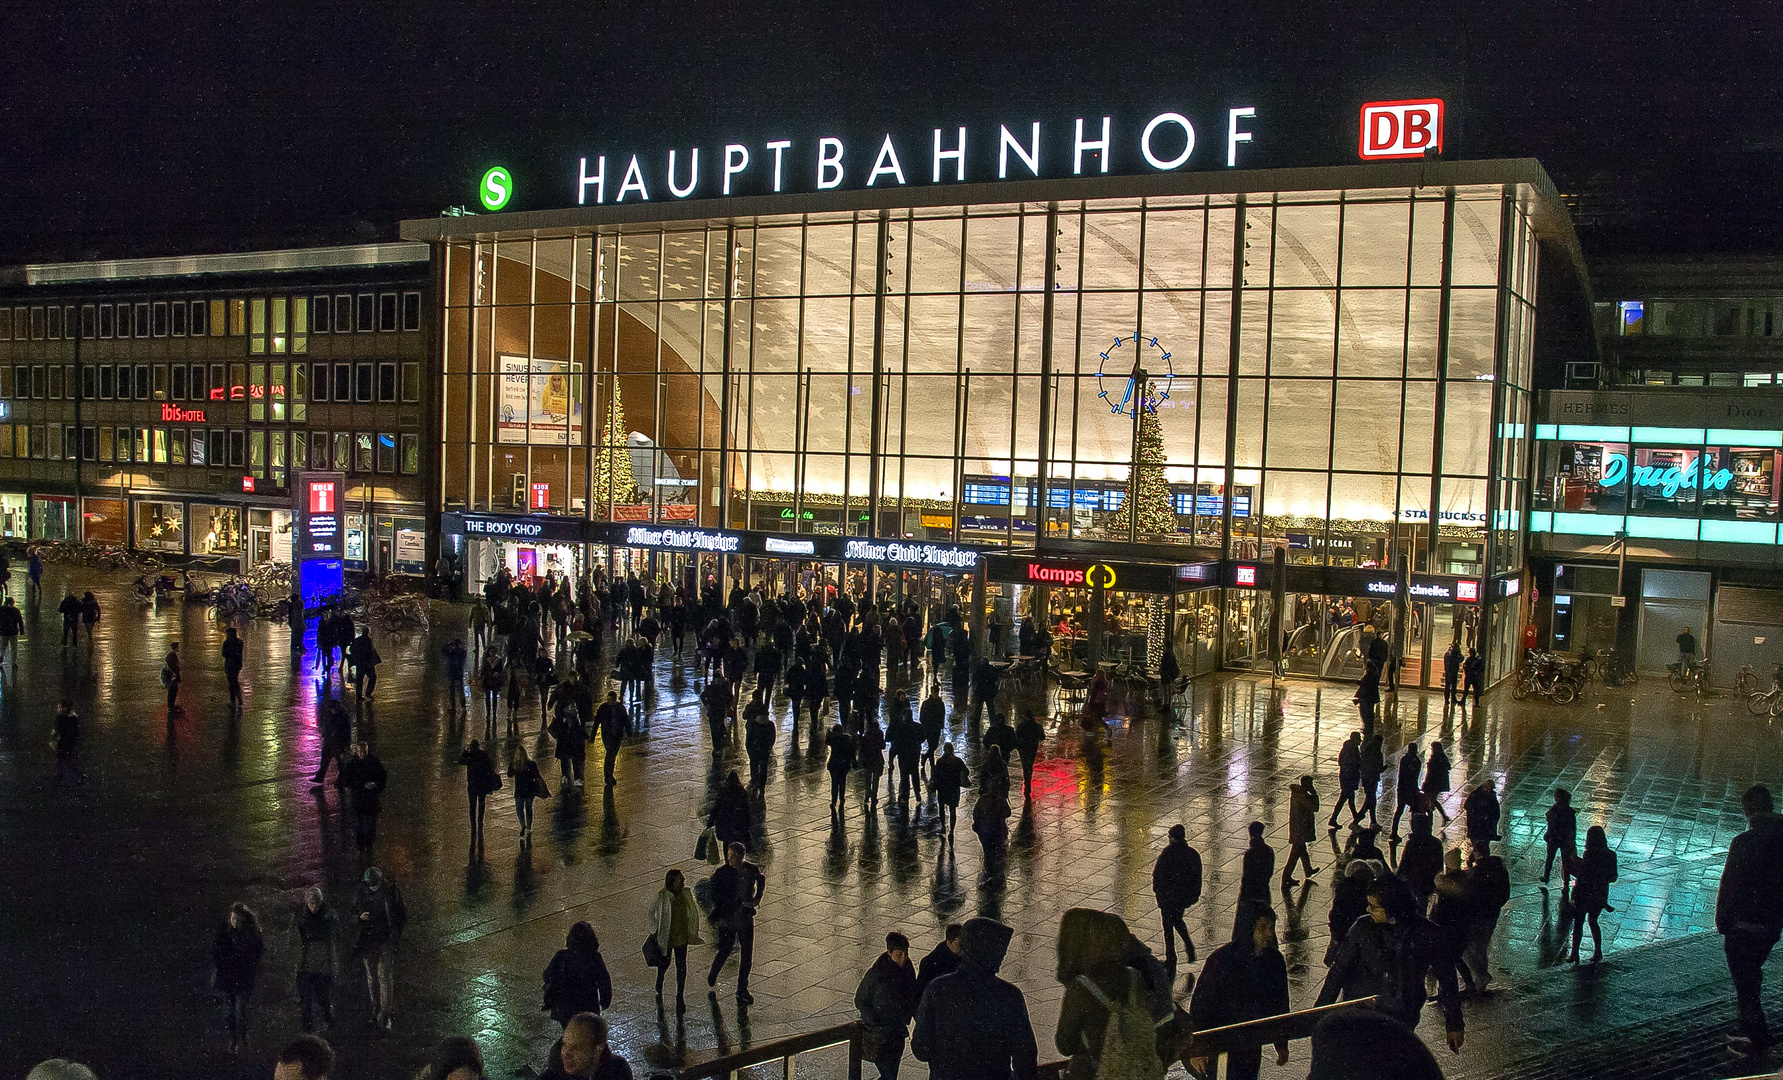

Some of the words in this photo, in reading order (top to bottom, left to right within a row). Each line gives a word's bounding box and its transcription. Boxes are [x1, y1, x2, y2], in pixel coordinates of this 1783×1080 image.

[1369, 109, 1432, 151] DB
[578, 106, 1256, 205] HAUPTBAHNHOF
[485, 171, 506, 206] S
[162, 403, 181, 421] ibis
[181, 411, 206, 422] HOTEL
[1599, 453, 1734, 498] Douglas
[465, 520, 484, 532] THE
[486, 522, 513, 534] BODY
[514, 524, 542, 536] SHOP
[1405, 509, 1477, 522] STABUCKS
[1028, 563, 1084, 585] Kamps
